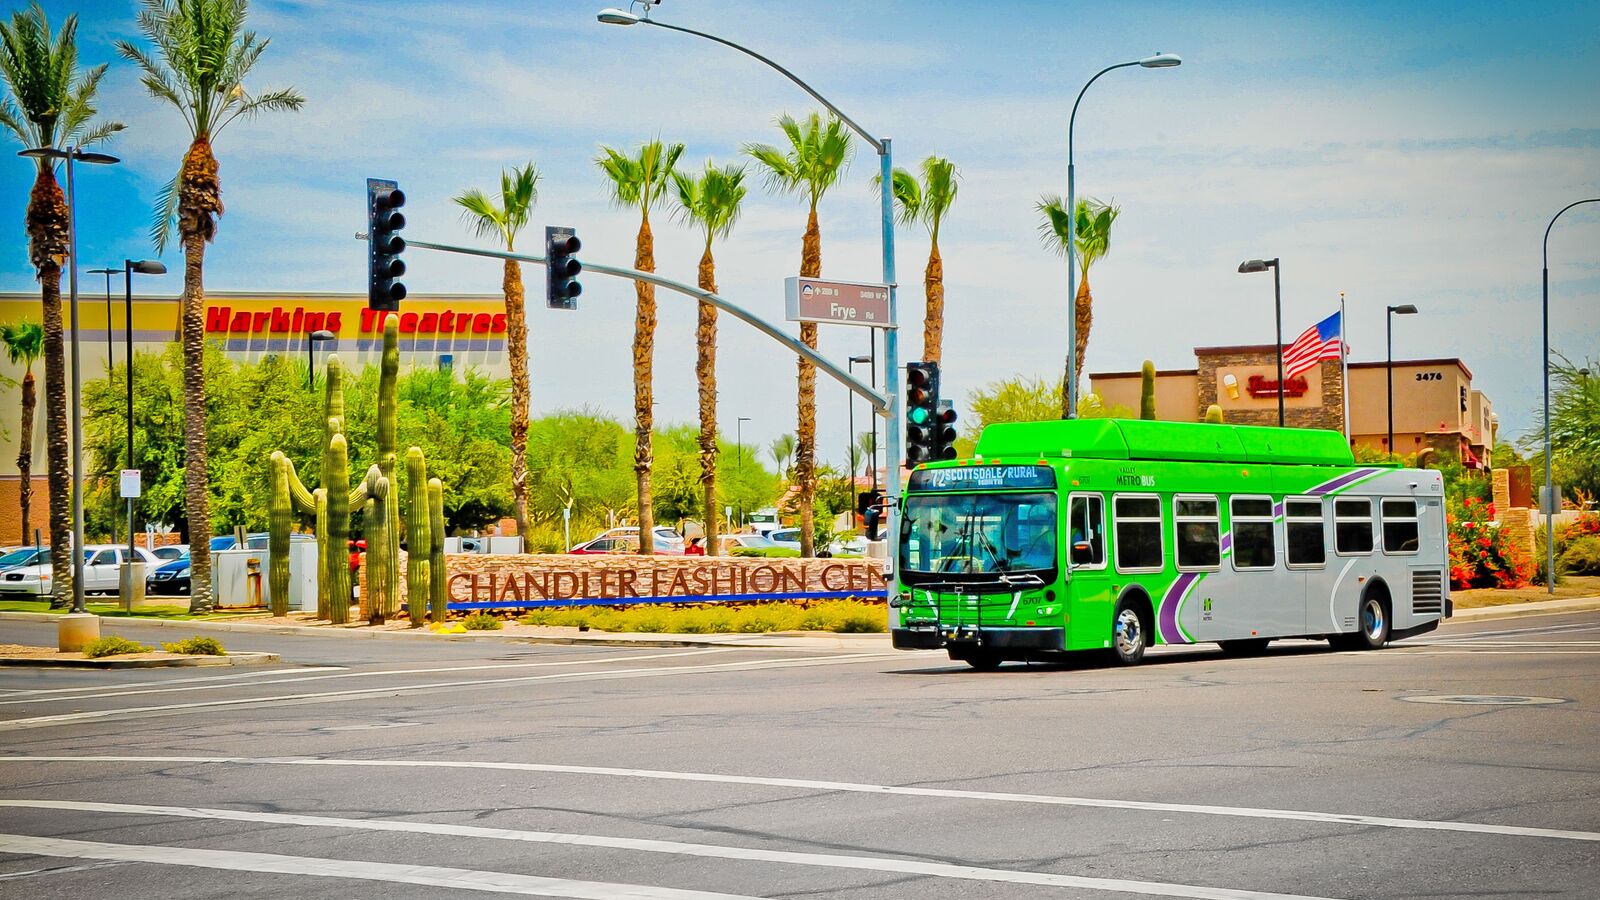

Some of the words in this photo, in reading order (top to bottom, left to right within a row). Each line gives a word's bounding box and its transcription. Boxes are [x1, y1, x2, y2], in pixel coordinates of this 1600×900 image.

[206, 307, 342, 333] Harkins
[830, 302, 857, 320] Frye
[865, 312, 874, 320] Rd
[1415, 372, 1443, 381] 3476
[930, 469, 946, 487] 72
[447, 569, 640, 603] CHANDLER
[652, 564, 806, 598] FASHION
[1023, 597, 1041, 605] 6707
